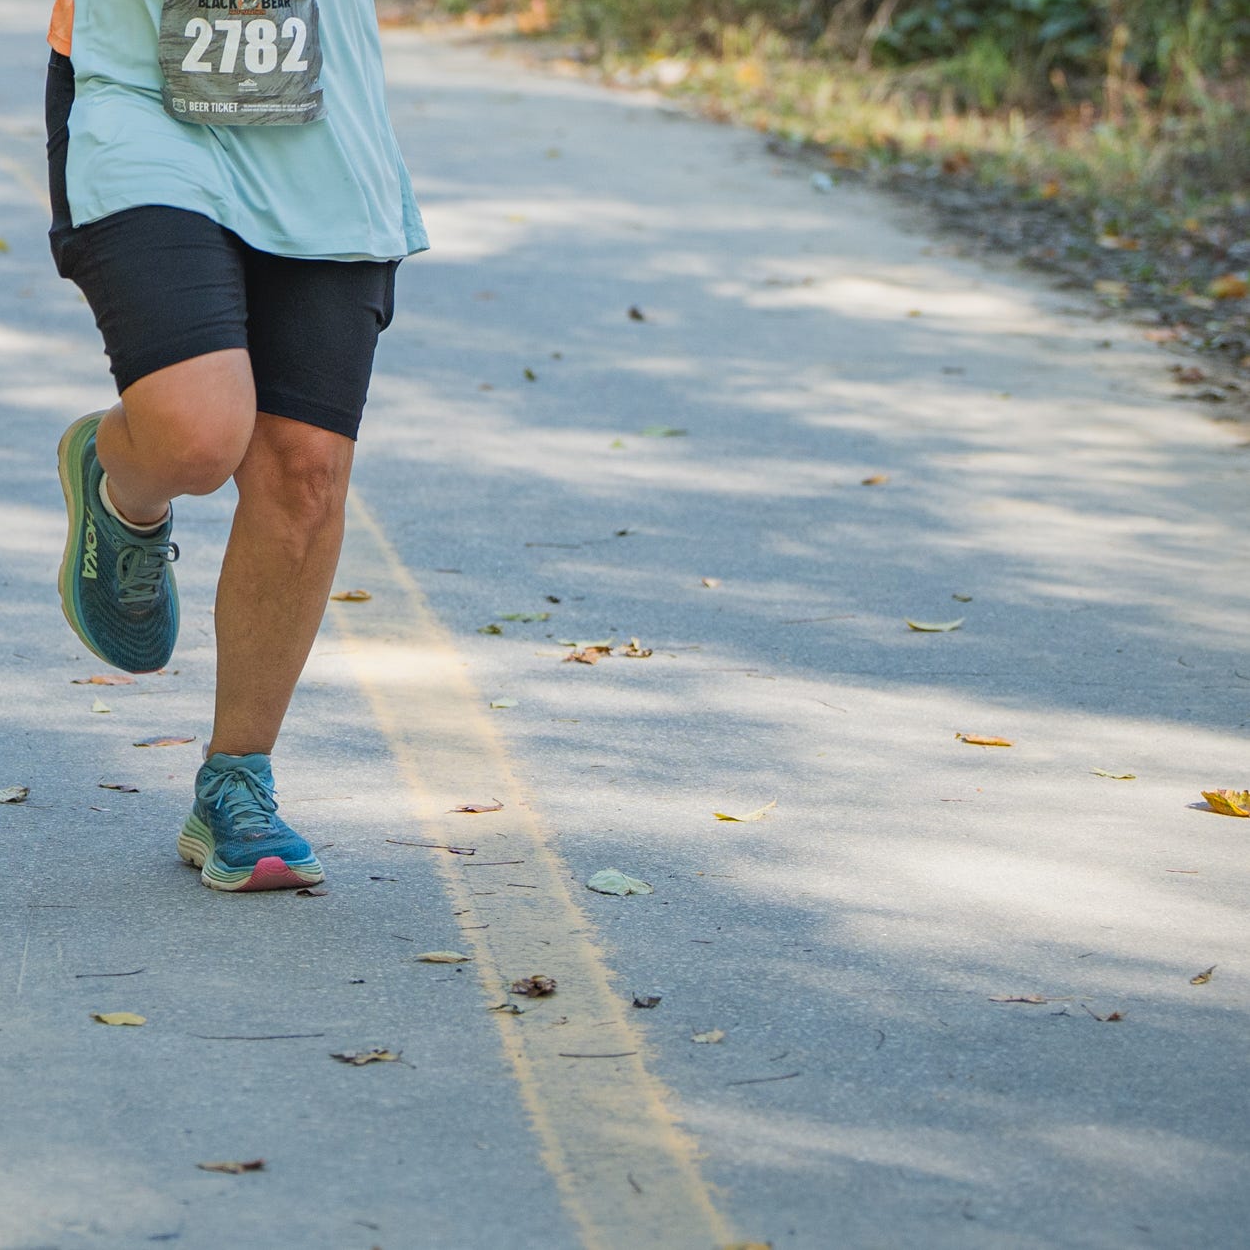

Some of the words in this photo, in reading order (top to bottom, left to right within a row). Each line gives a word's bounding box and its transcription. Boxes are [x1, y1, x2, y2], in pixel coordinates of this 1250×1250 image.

[181, 17, 308, 74] 2782
[189, 102, 209, 112] BEER
[211, 102, 238, 113] TICKET
[82, 506, 98, 579] HOKA
